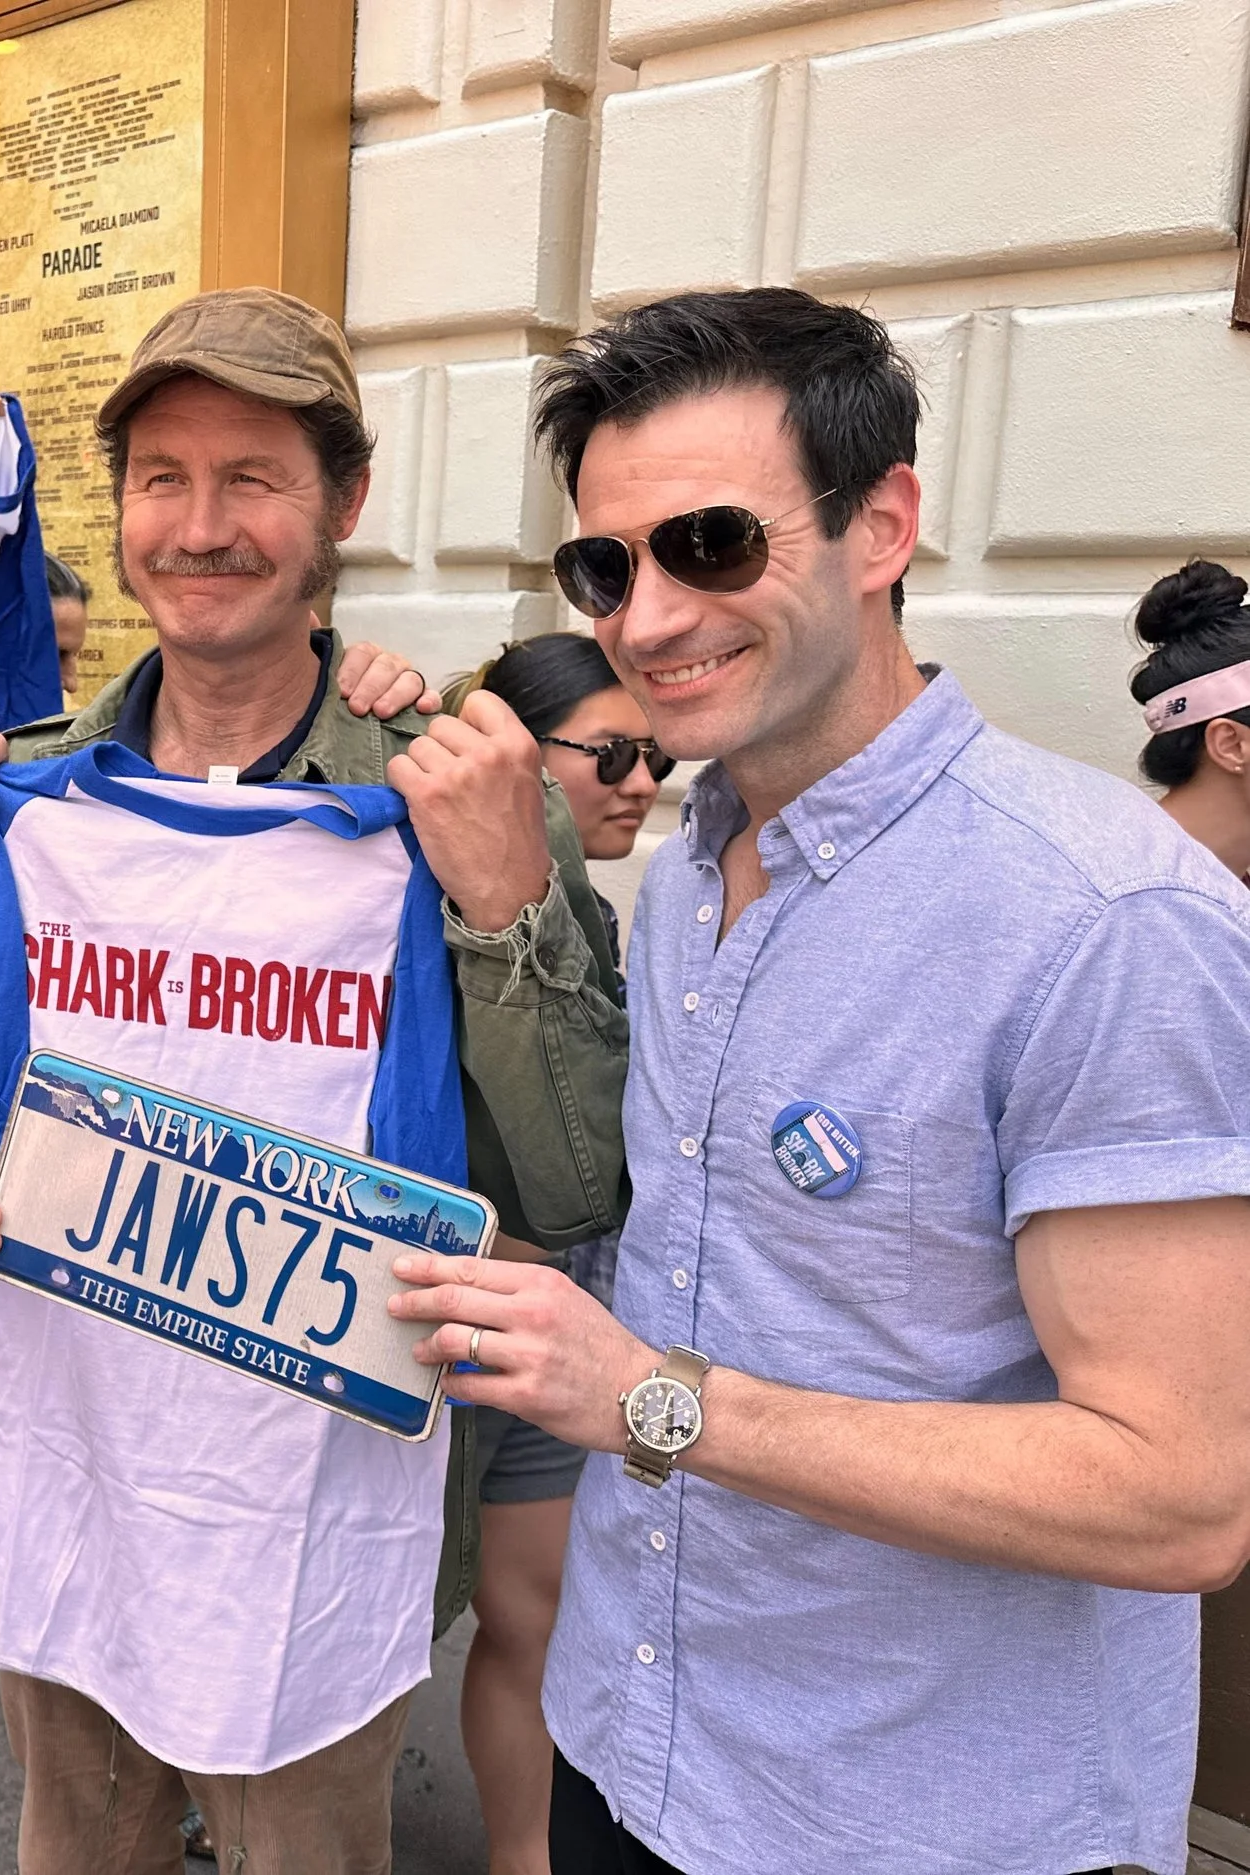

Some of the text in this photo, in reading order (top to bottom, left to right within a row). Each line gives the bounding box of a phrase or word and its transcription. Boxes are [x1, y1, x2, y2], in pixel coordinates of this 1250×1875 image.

[80, 206, 160, 236] MICAELA DIAMOND
[10, 233, 34, 250] PLATT
[42, 242, 103, 278] PARADE
[77, 284, 105, 301] JASON
[106, 277, 139, 296] ROBERT
[141, 271, 175, 290] BROWN
[42, 324, 74, 342] HAROLD
[75, 320, 105, 337] PRINCE
[39, 921, 72, 937] THE
[23, 933, 393, 1051] SHARK IS BROKEN
[817, 1113, 835, 1132] GOT
[830, 1129, 860, 1158] BITTEN
[120, 1094, 368, 1219] NEW YORK
[774, 1144, 809, 1188] BROKEN
[65, 1148, 374, 1346] JAWS75
[78, 1275, 311, 1386] THE EMPIRE STATE
